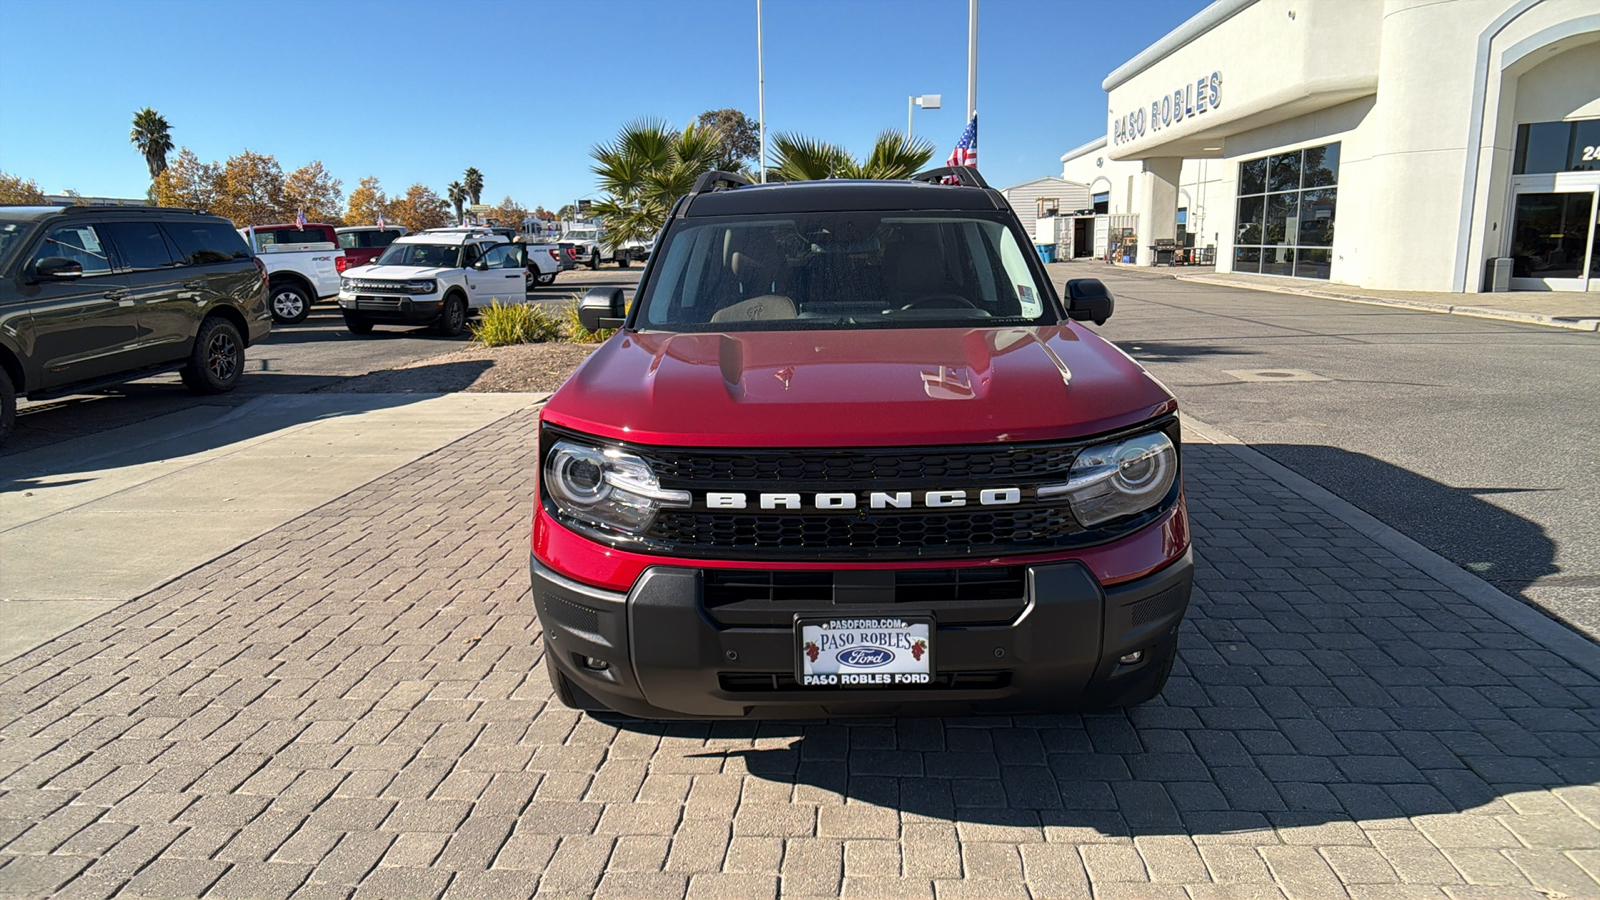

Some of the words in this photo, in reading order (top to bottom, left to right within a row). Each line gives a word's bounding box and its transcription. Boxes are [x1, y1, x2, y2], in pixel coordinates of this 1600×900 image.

[1114, 107, 1147, 145] PASO
[1151, 70, 1222, 132] ROBLES
[706, 487, 1021, 509] BRONCO
[829, 619, 902, 630] PASOFORD.COM
[820, 632, 855, 652] PASO
[860, 632, 912, 650] ROBLES
[848, 649, 884, 665] Ford
[804, 674, 838, 686] PASO
[841, 674, 892, 685] ROBLES
[895, 674, 930, 684] FORD
